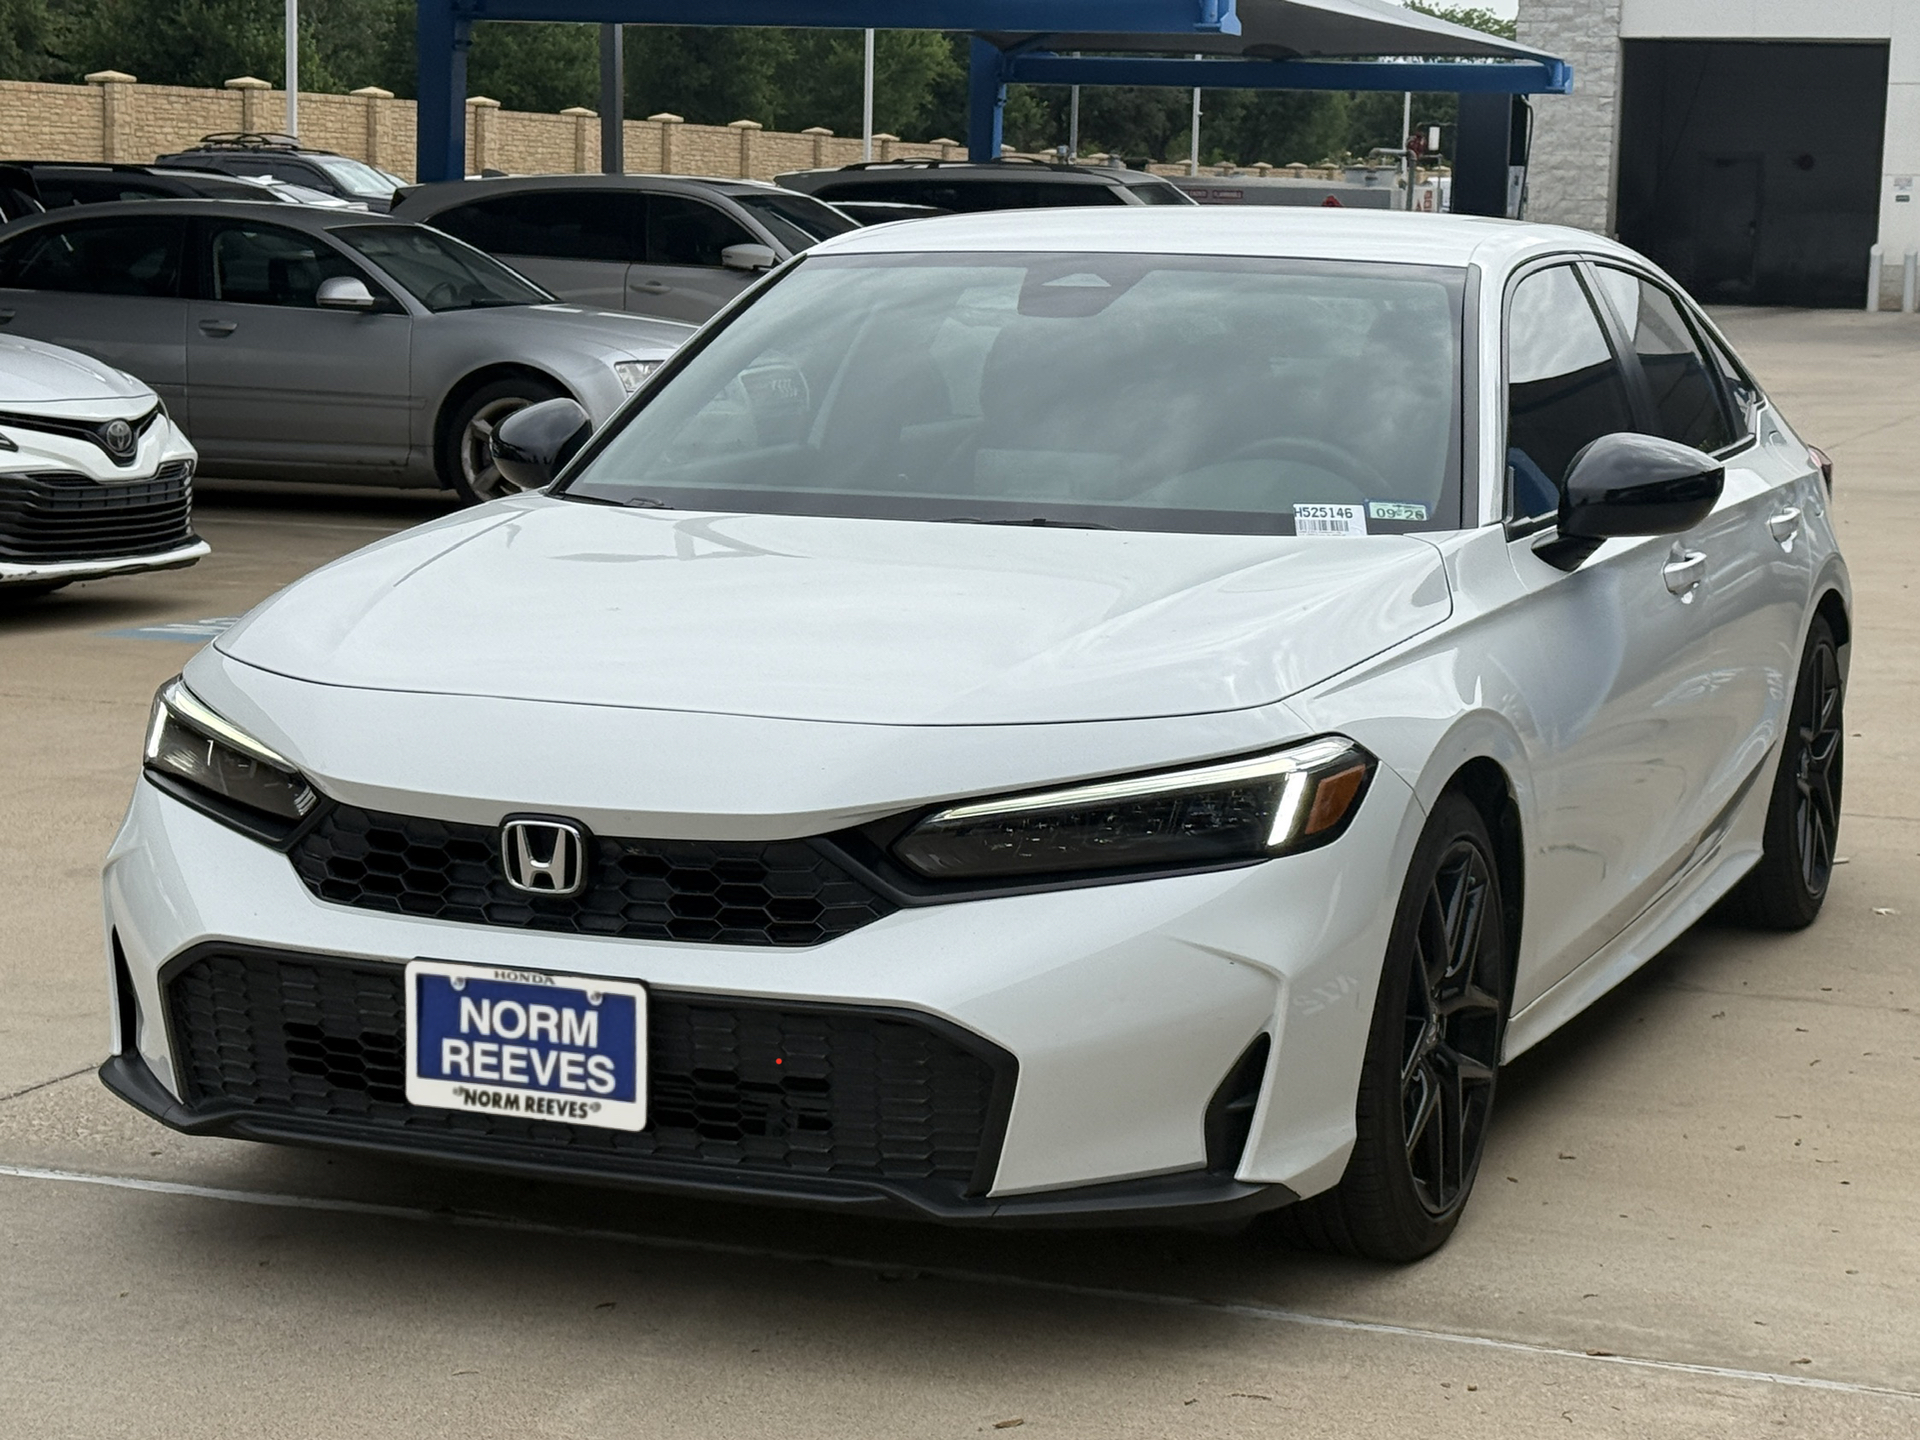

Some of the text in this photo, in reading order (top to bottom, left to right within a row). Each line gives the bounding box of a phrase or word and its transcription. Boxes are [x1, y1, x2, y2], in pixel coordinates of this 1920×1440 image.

[1294, 507, 1353, 519] H525146
[494, 970, 556, 985] HONDA
[460, 996, 599, 1049] NORM
[441, 1037, 616, 1094] REEVES
[463, 1088, 588, 1119] NORM REEVES
